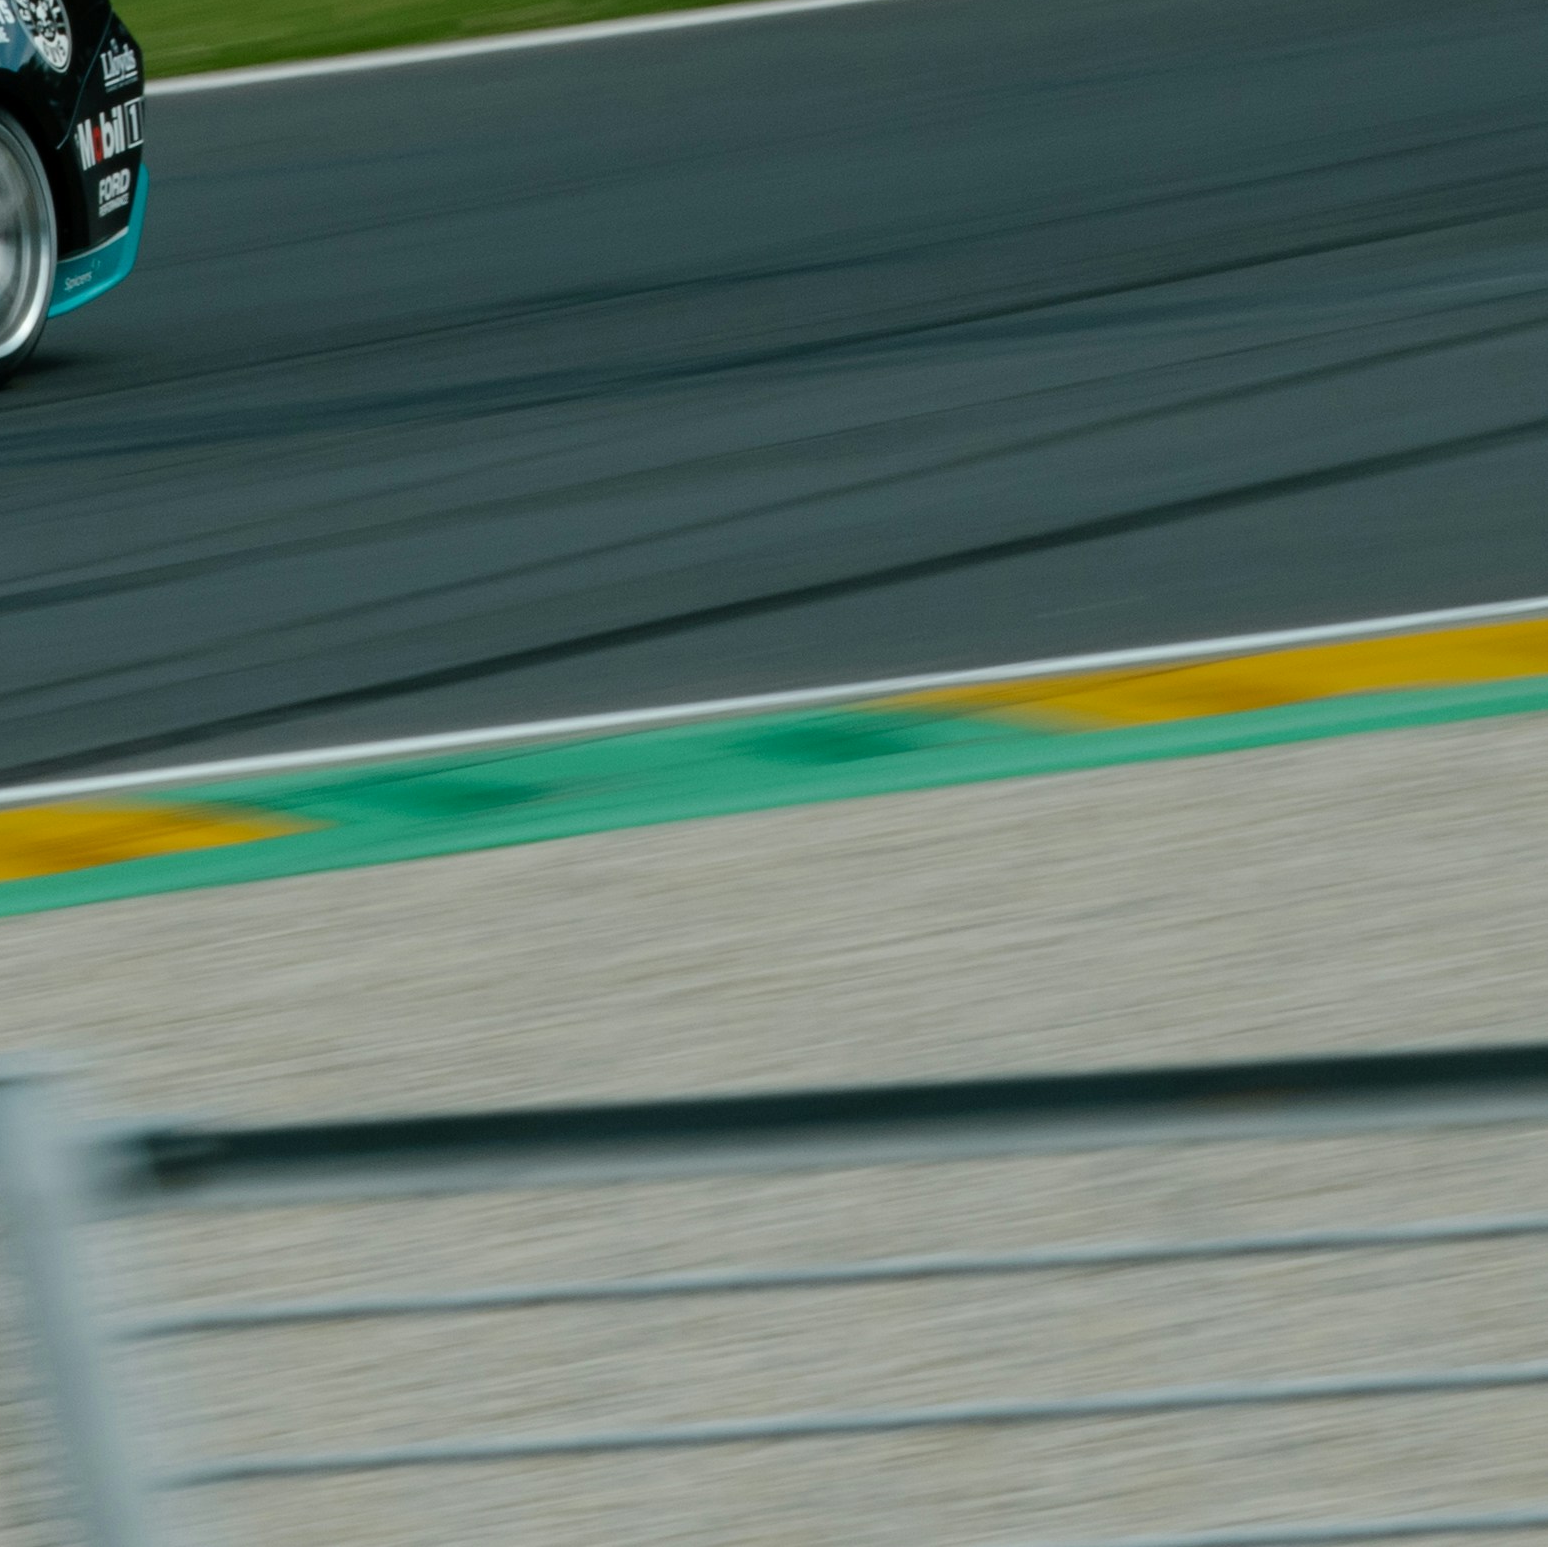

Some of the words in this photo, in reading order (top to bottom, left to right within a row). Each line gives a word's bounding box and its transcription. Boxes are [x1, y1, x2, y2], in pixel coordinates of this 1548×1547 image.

[76, 104, 126, 171] Mobil
[129, 105, 139, 142] 1
[99, 168, 131, 205] FORD
